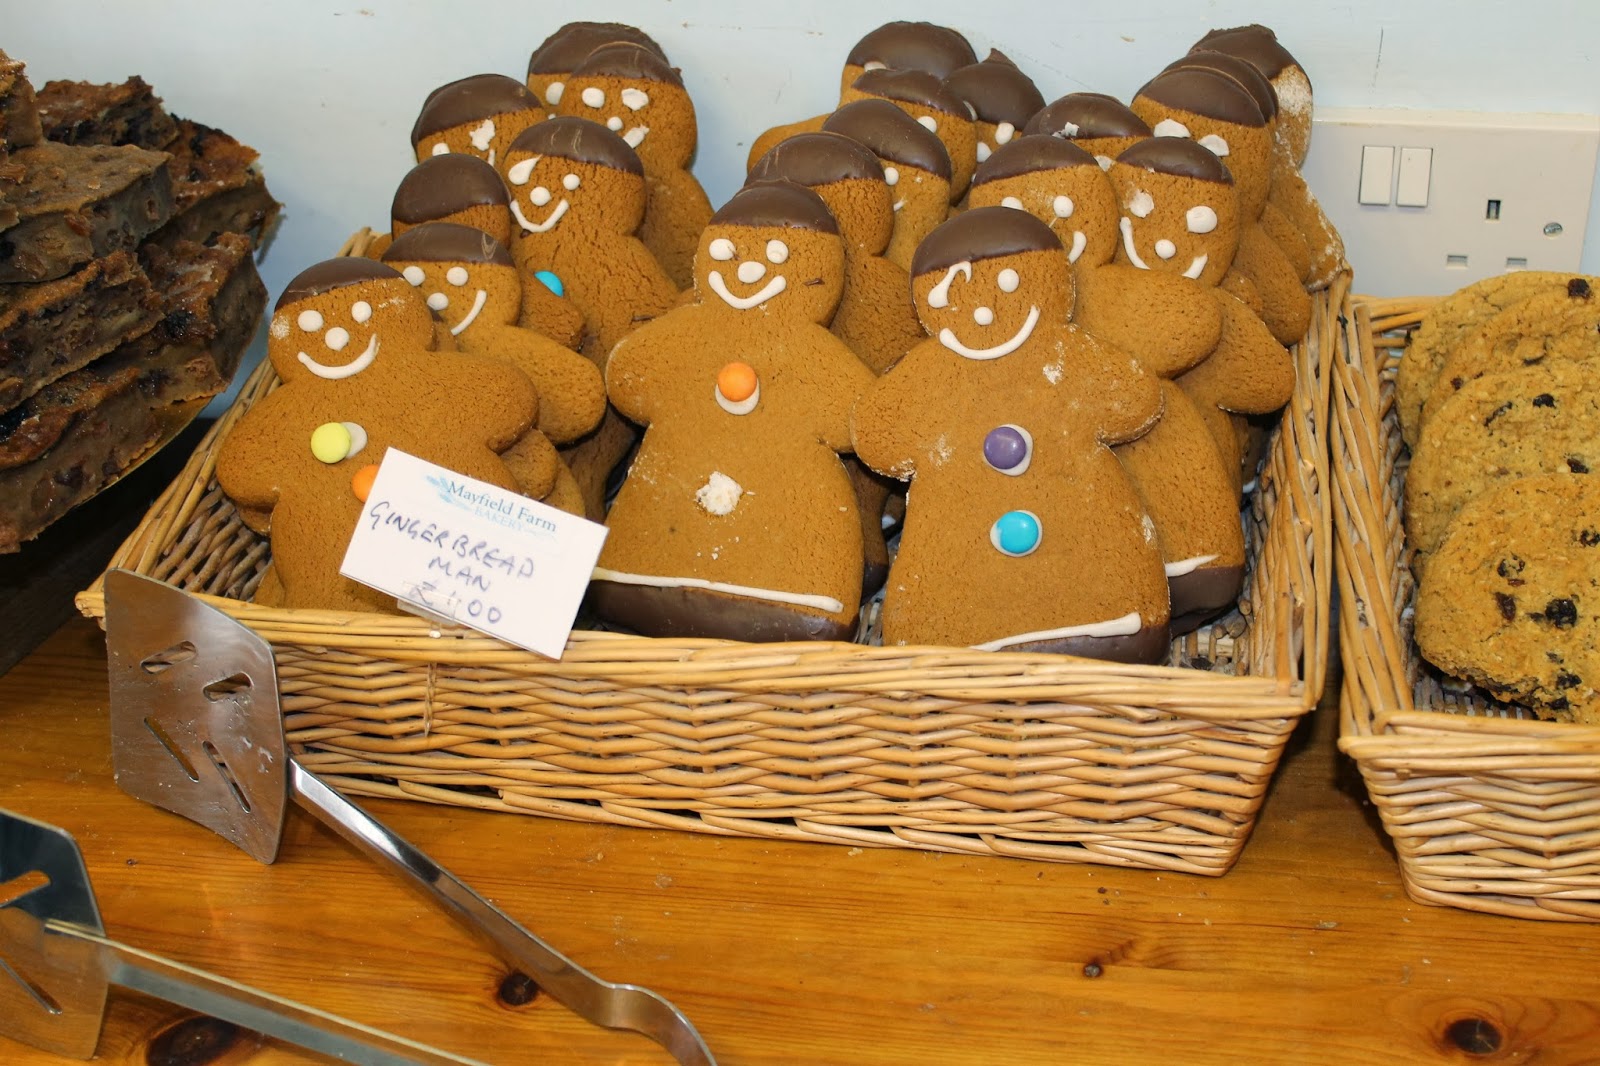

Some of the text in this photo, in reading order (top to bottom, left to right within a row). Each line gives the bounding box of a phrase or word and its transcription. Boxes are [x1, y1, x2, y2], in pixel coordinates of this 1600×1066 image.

[448, 481, 557, 532] Mayfield Farm
[474, 507, 524, 532] BAKERY
[428, 556, 491, 591] MAN
